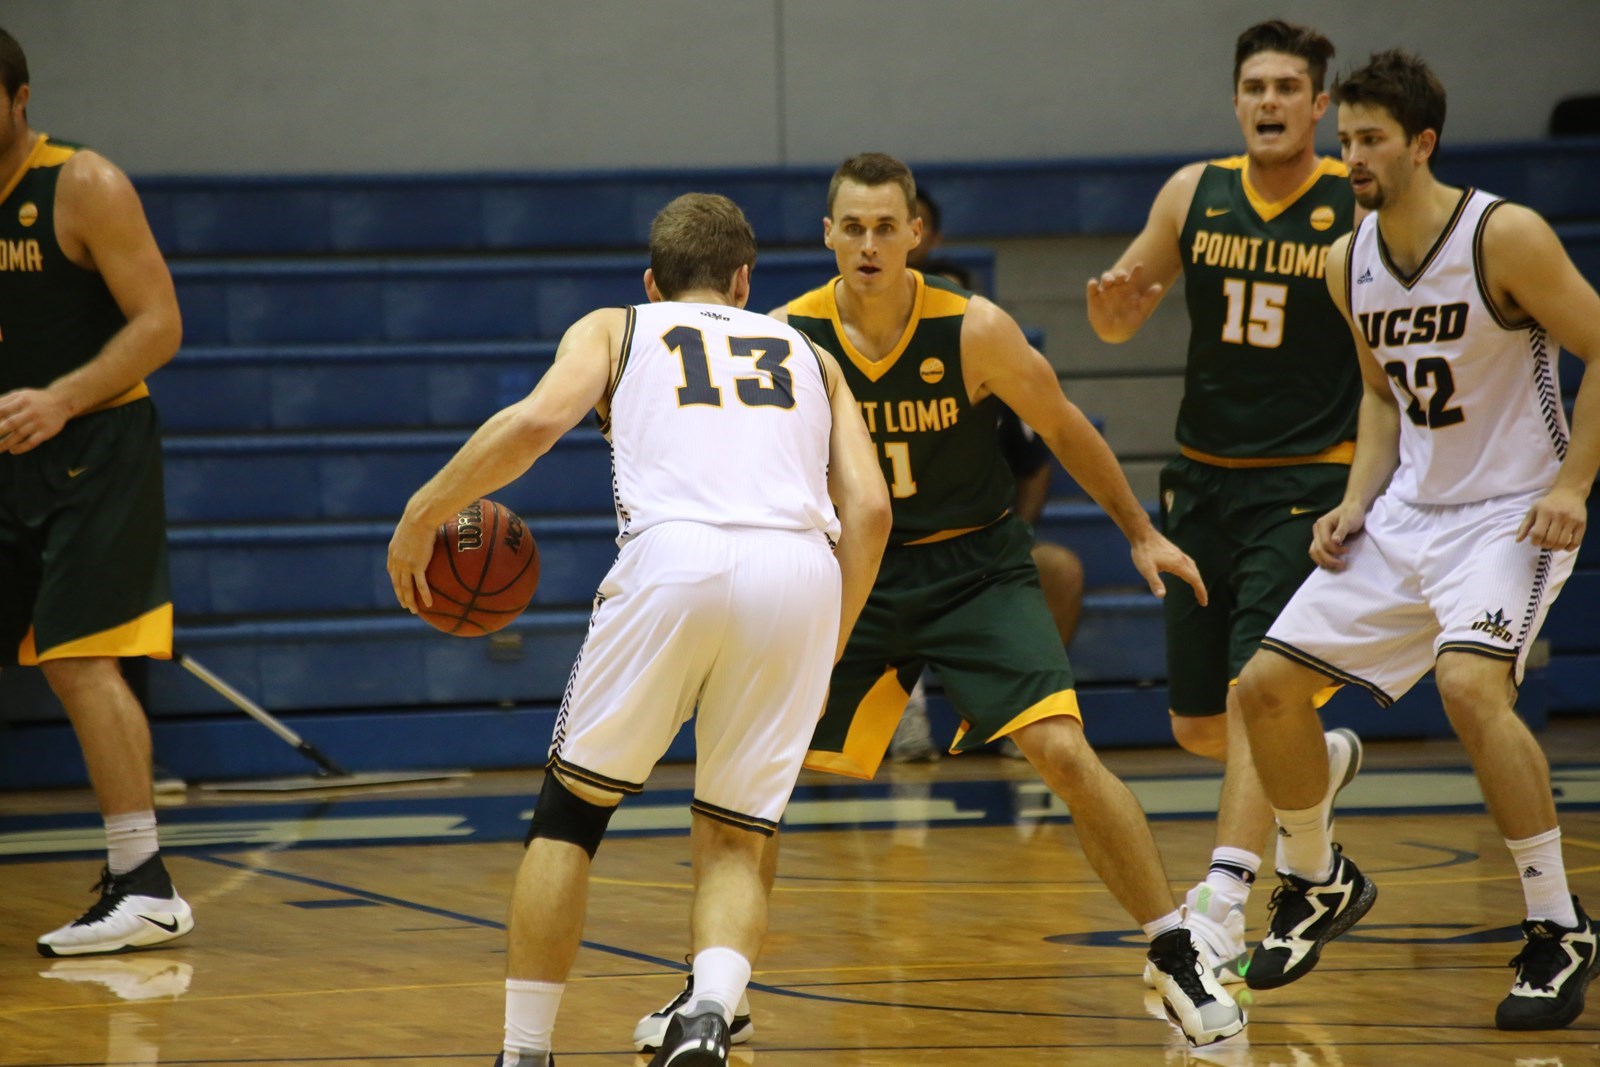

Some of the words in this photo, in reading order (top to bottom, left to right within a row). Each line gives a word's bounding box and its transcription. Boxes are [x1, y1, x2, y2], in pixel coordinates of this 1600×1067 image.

[0, 238, 43, 272] OMA
[1191, 229, 1263, 272] POINT
[1221, 277, 1288, 348] 15
[1358, 302, 1469, 349] UCSD
[660, 325, 797, 411] 13
[884, 397, 960, 433] LOMA
[872, 442, 917, 498] 1
